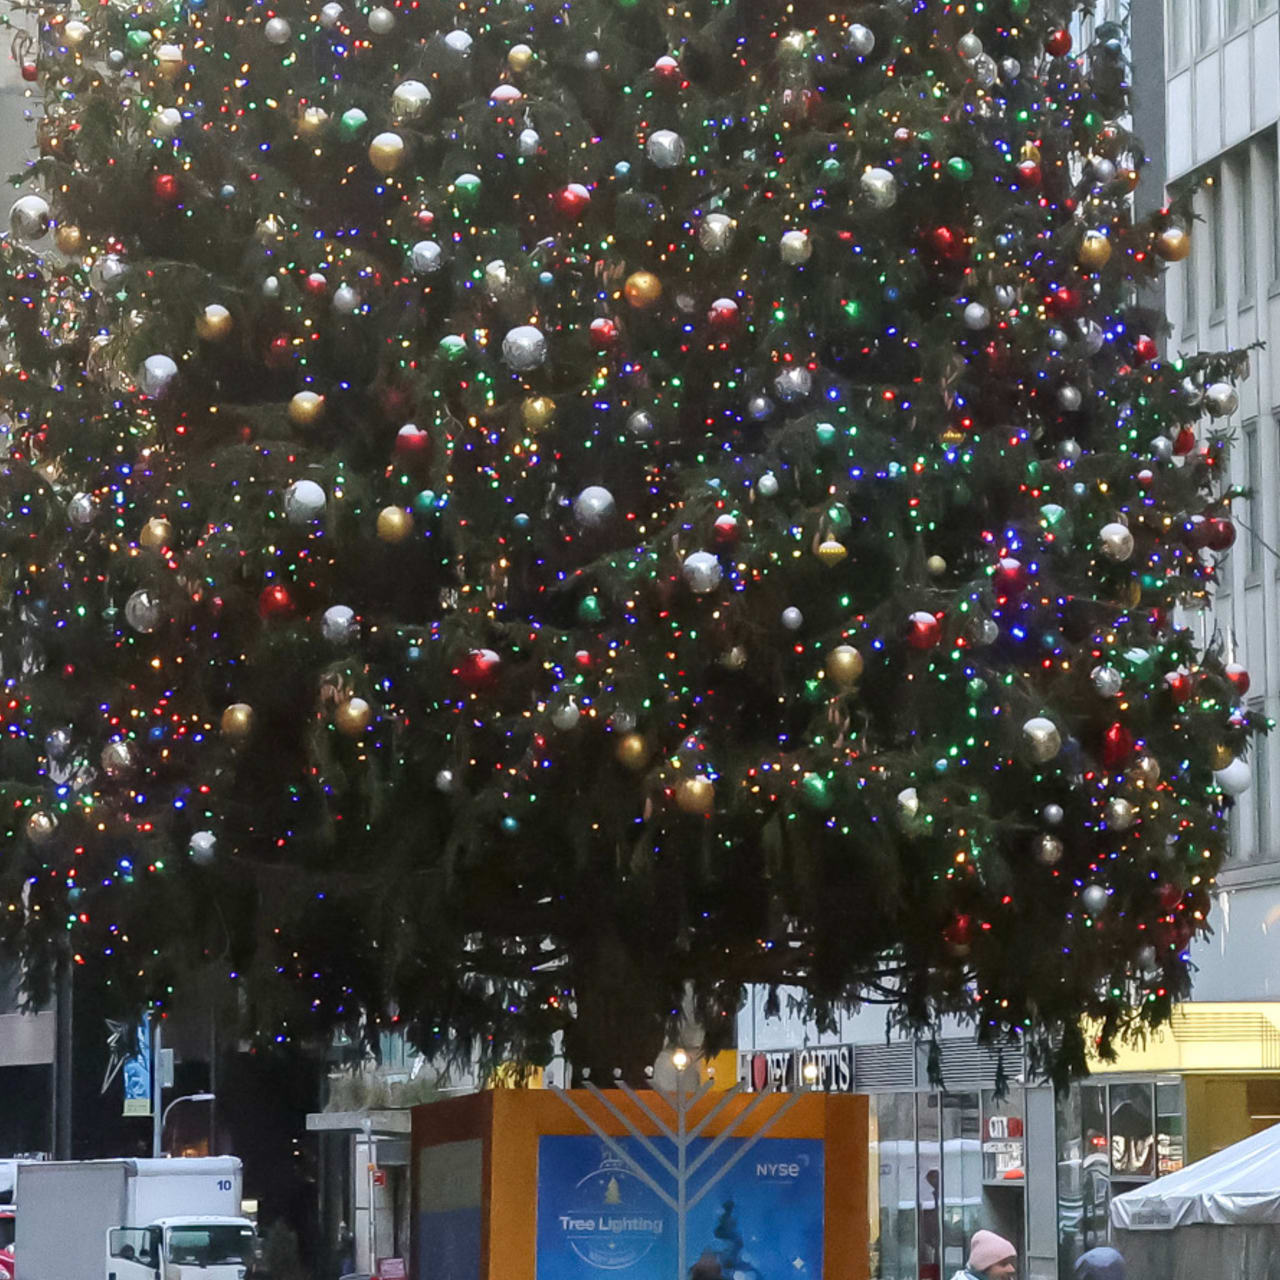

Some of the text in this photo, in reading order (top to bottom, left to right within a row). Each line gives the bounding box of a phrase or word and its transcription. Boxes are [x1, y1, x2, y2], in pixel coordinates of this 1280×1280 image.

[217, 1180, 232, 1191] 10
[560, 1216, 664, 1234] Tree Lighting
